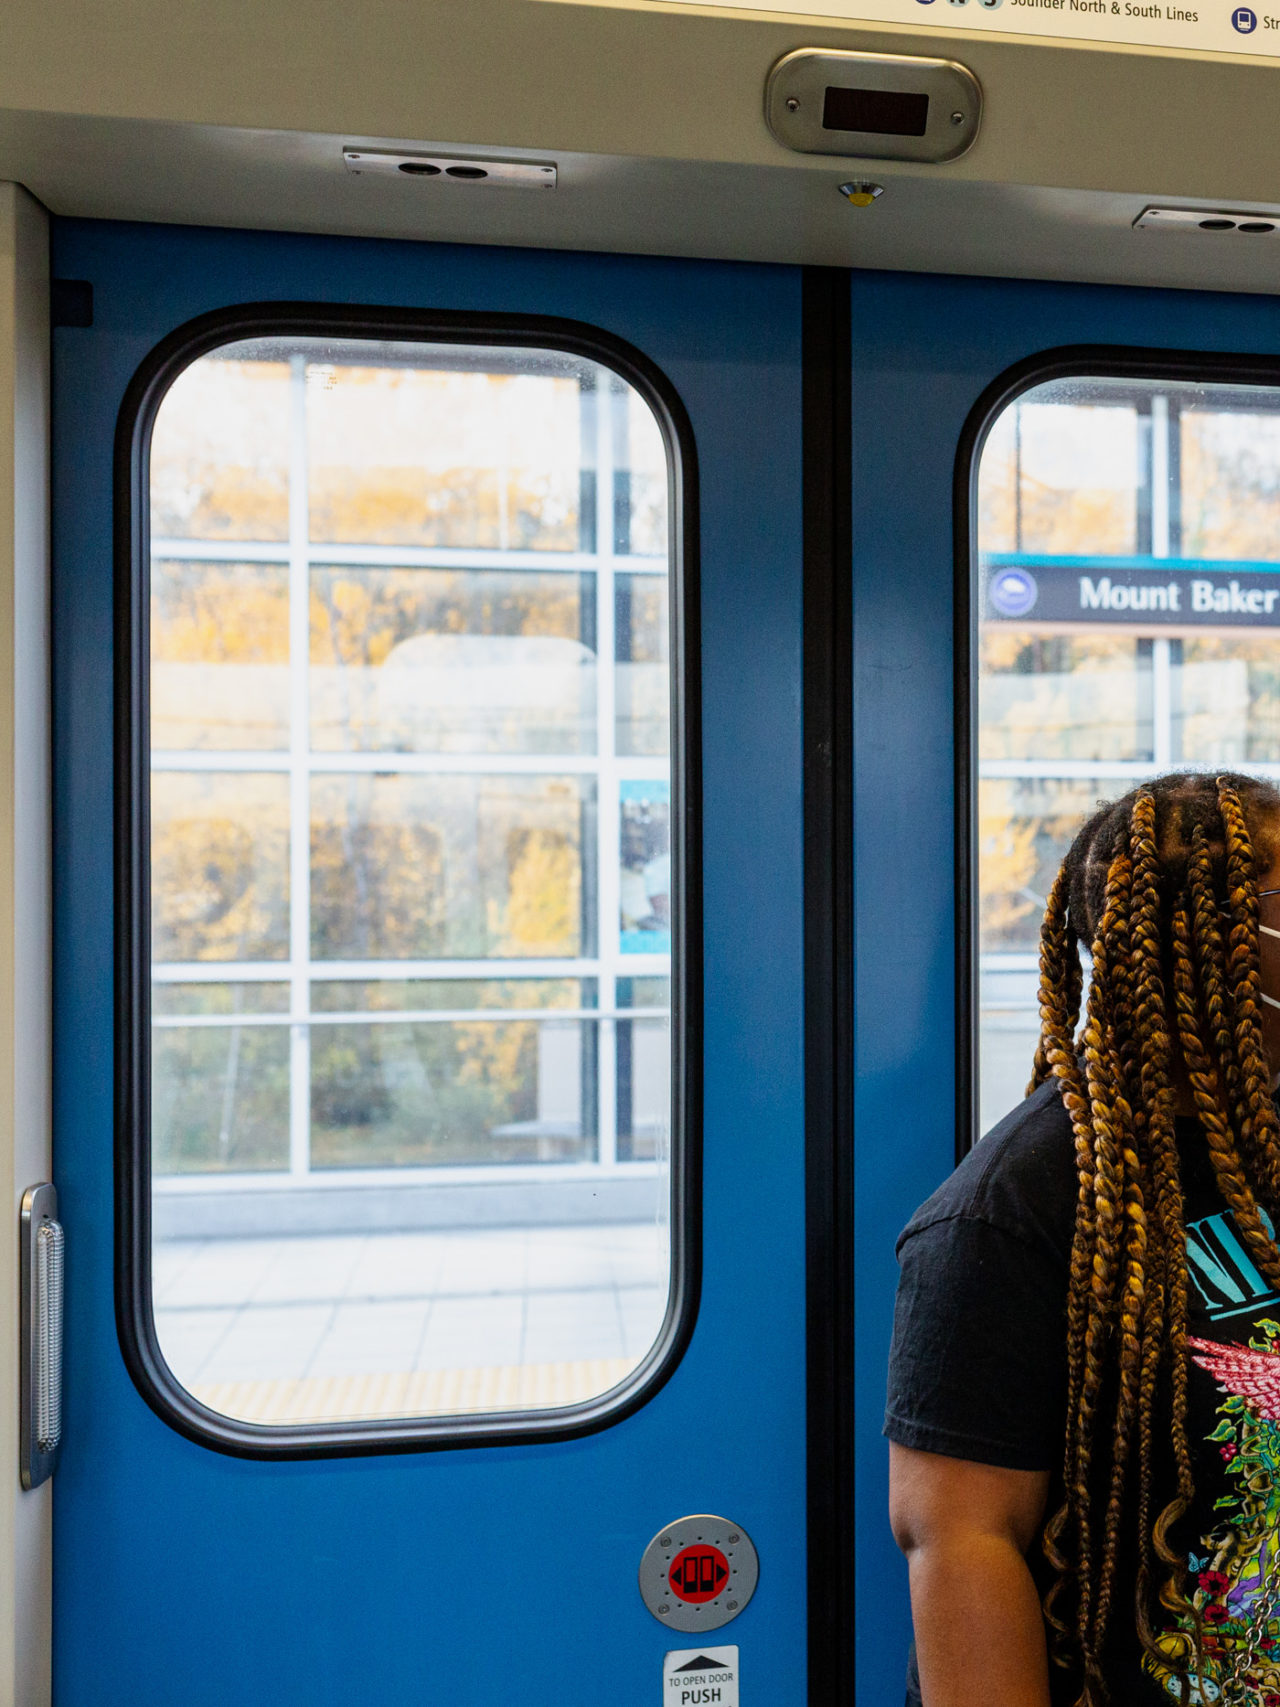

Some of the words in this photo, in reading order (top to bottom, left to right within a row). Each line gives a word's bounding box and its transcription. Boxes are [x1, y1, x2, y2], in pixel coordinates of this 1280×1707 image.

[1070, 0, 1106, 13] North
[1111, 1, 1120, 15] &
[1125, 2, 1162, 19] South
[1166, 6, 1199, 22] Lines
[1080, 576, 1181, 612] Mount
[1191, 579, 1280, 614] Baker
[669, 1678, 681, 1687] TO
[683, 1675, 706, 1686] OPEN
[708, 1673, 734, 1683] DOOR
[681, 1687, 721, 1706] PUSH
